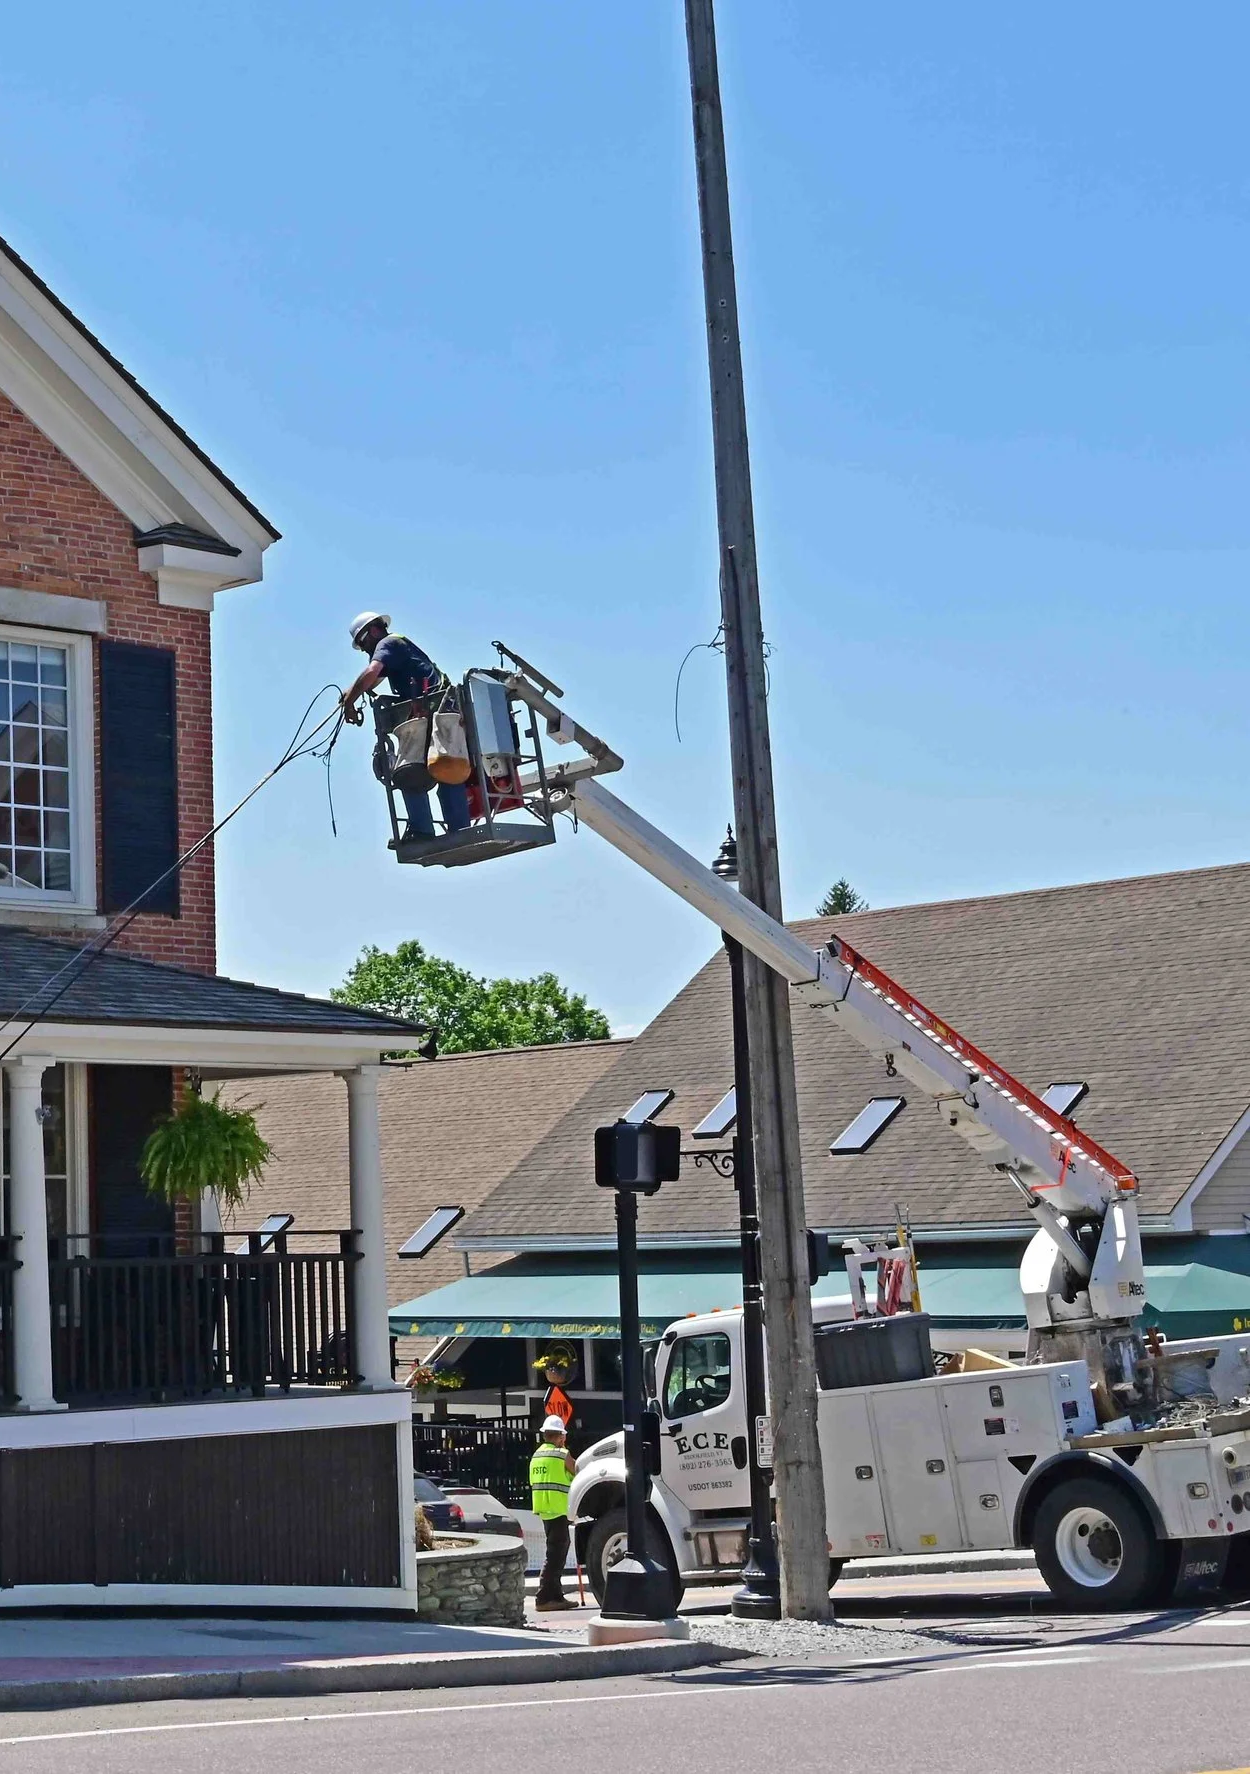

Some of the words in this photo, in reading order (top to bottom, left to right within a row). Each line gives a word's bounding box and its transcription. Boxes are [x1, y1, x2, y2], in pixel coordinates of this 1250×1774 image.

[640, 1323, 657, 1334] Pub
[673, 1432, 729, 1455] ECE
[687, 1482, 710, 1491] USDOT
